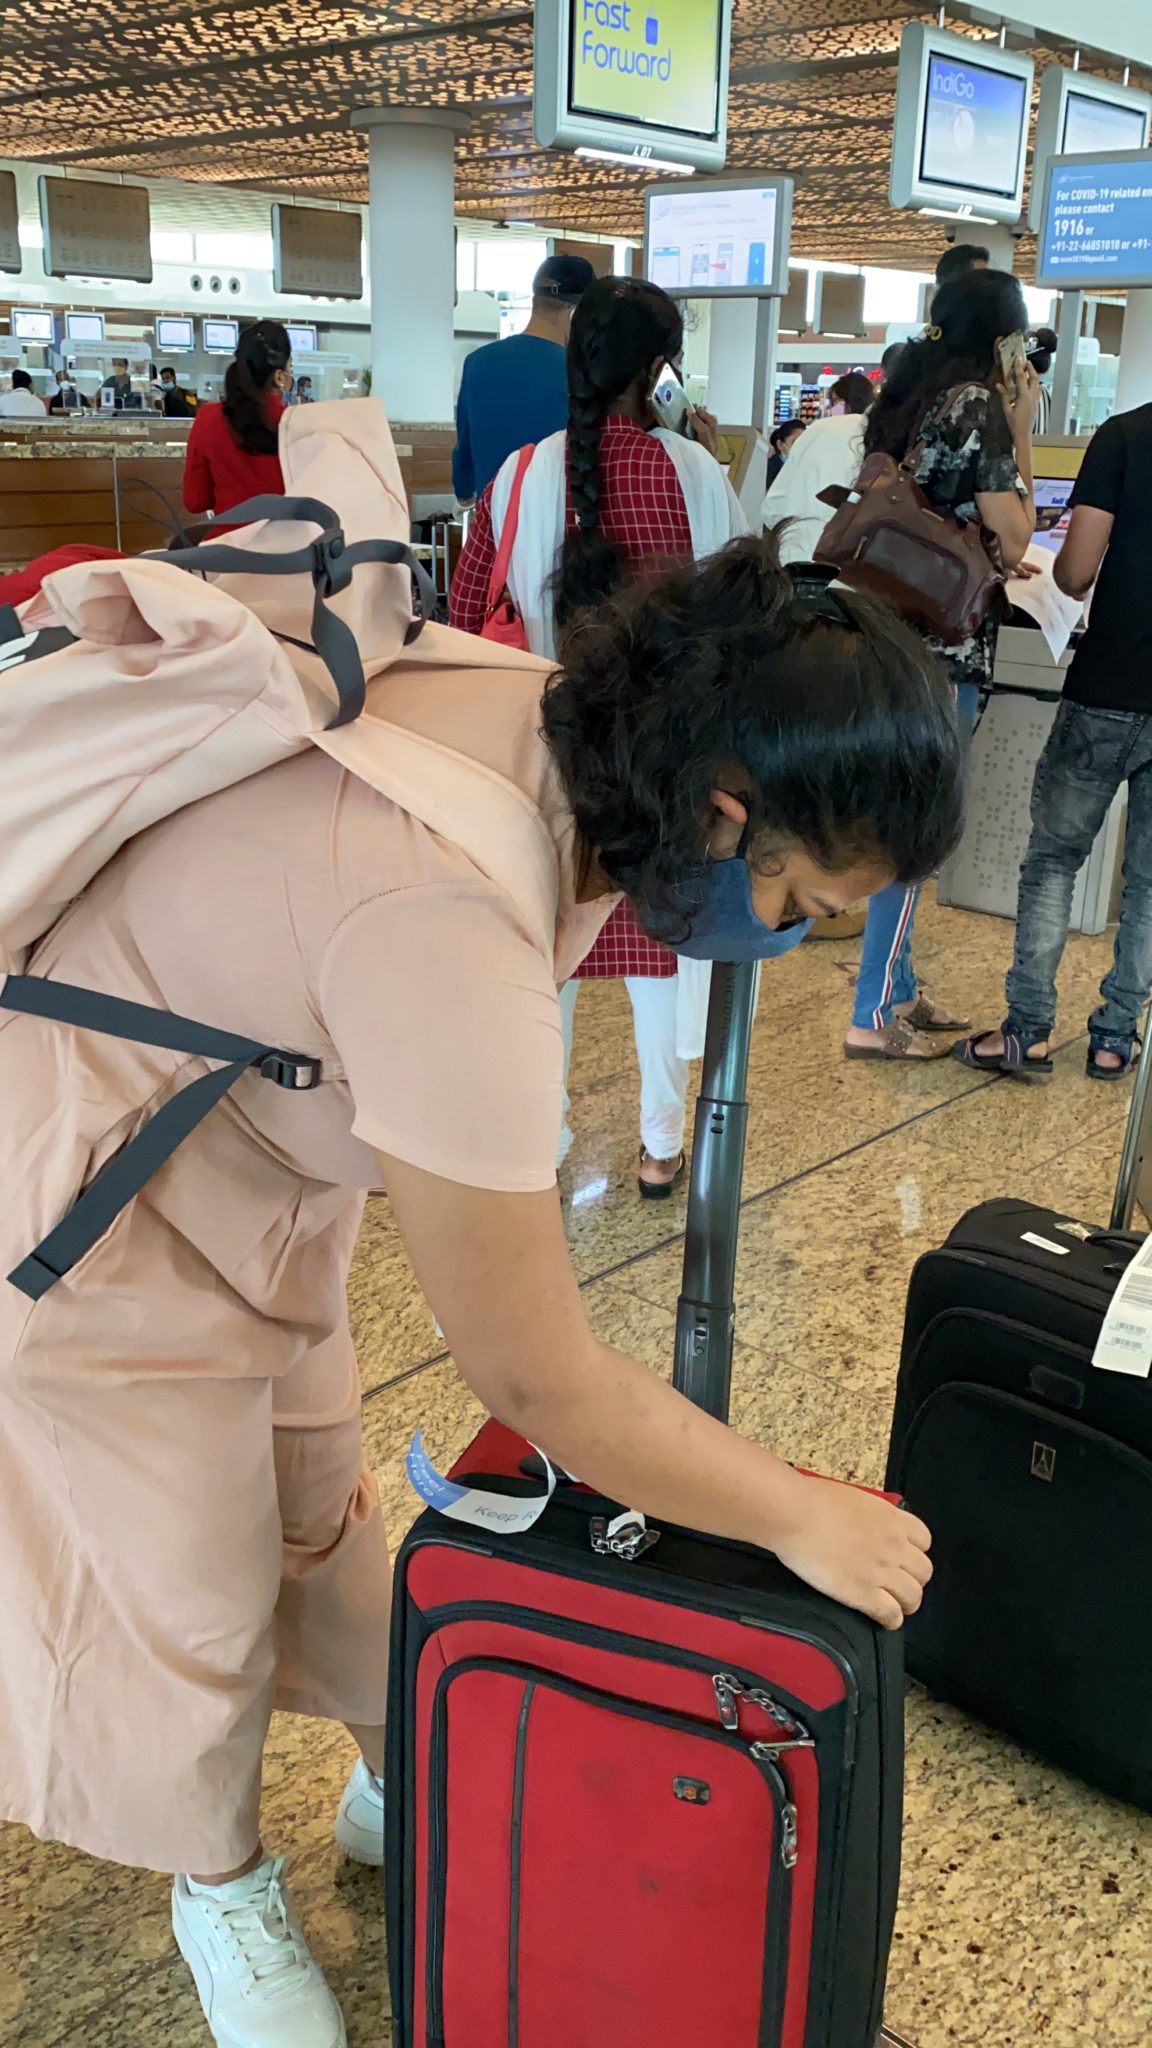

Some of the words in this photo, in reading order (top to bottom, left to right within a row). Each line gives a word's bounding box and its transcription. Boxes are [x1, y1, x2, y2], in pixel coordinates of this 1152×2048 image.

[932, 66, 975, 99] IndiGo
[1056, 190, 1069, 201] For
[1071, 188, 1109, 200] COVID-19
[1110, 187, 1141, 198] related
[1055, 205, 1081, 217] please
[1083, 203, 1114, 214] contact
[1054, 219, 1084, 236] 1916
[1085, 226, 1094, 235] or
[1121, 240, 1131, 250] or
[474, 1505, 519, 1523] Keep
